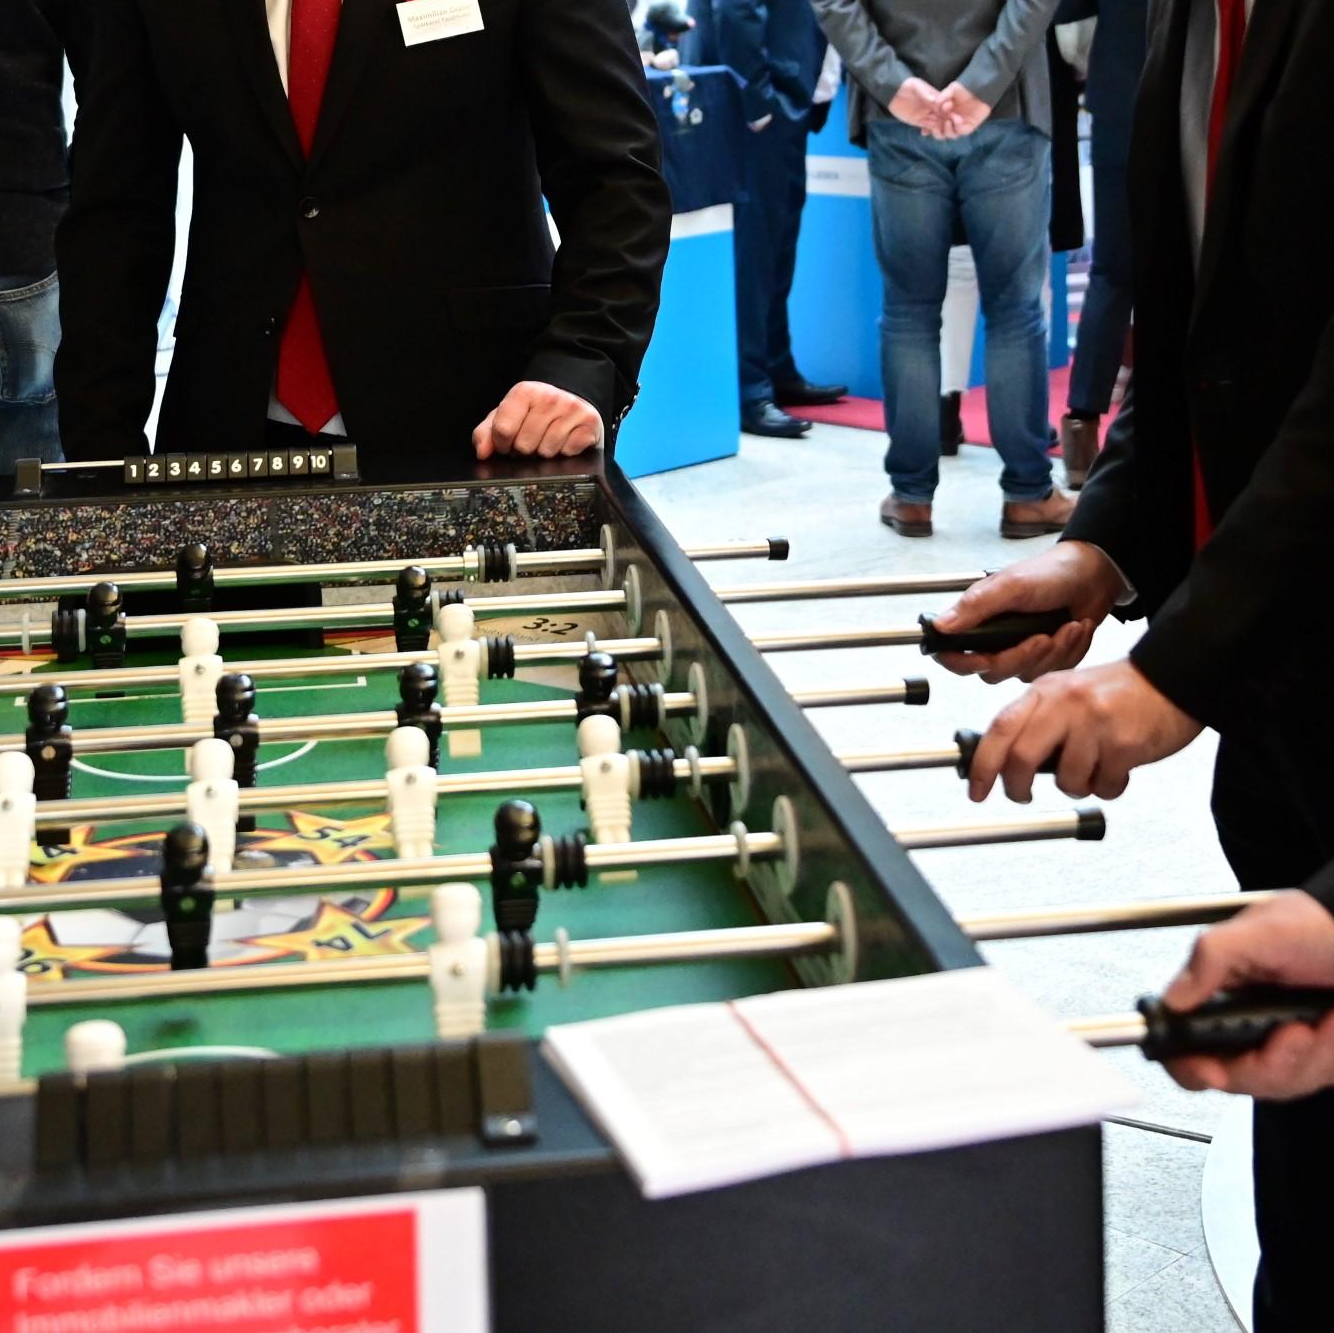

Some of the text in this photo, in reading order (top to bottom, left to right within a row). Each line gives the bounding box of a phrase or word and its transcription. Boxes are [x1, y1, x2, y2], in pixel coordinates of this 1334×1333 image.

[130, 455, 326, 478] 1 2 3 4 5 6 7 8 9 10
[523, 617, 578, 635] 3:2
[14, 1245, 320, 1301] Fordern Sie unsere
[298, 1279, 373, 1313] oder
